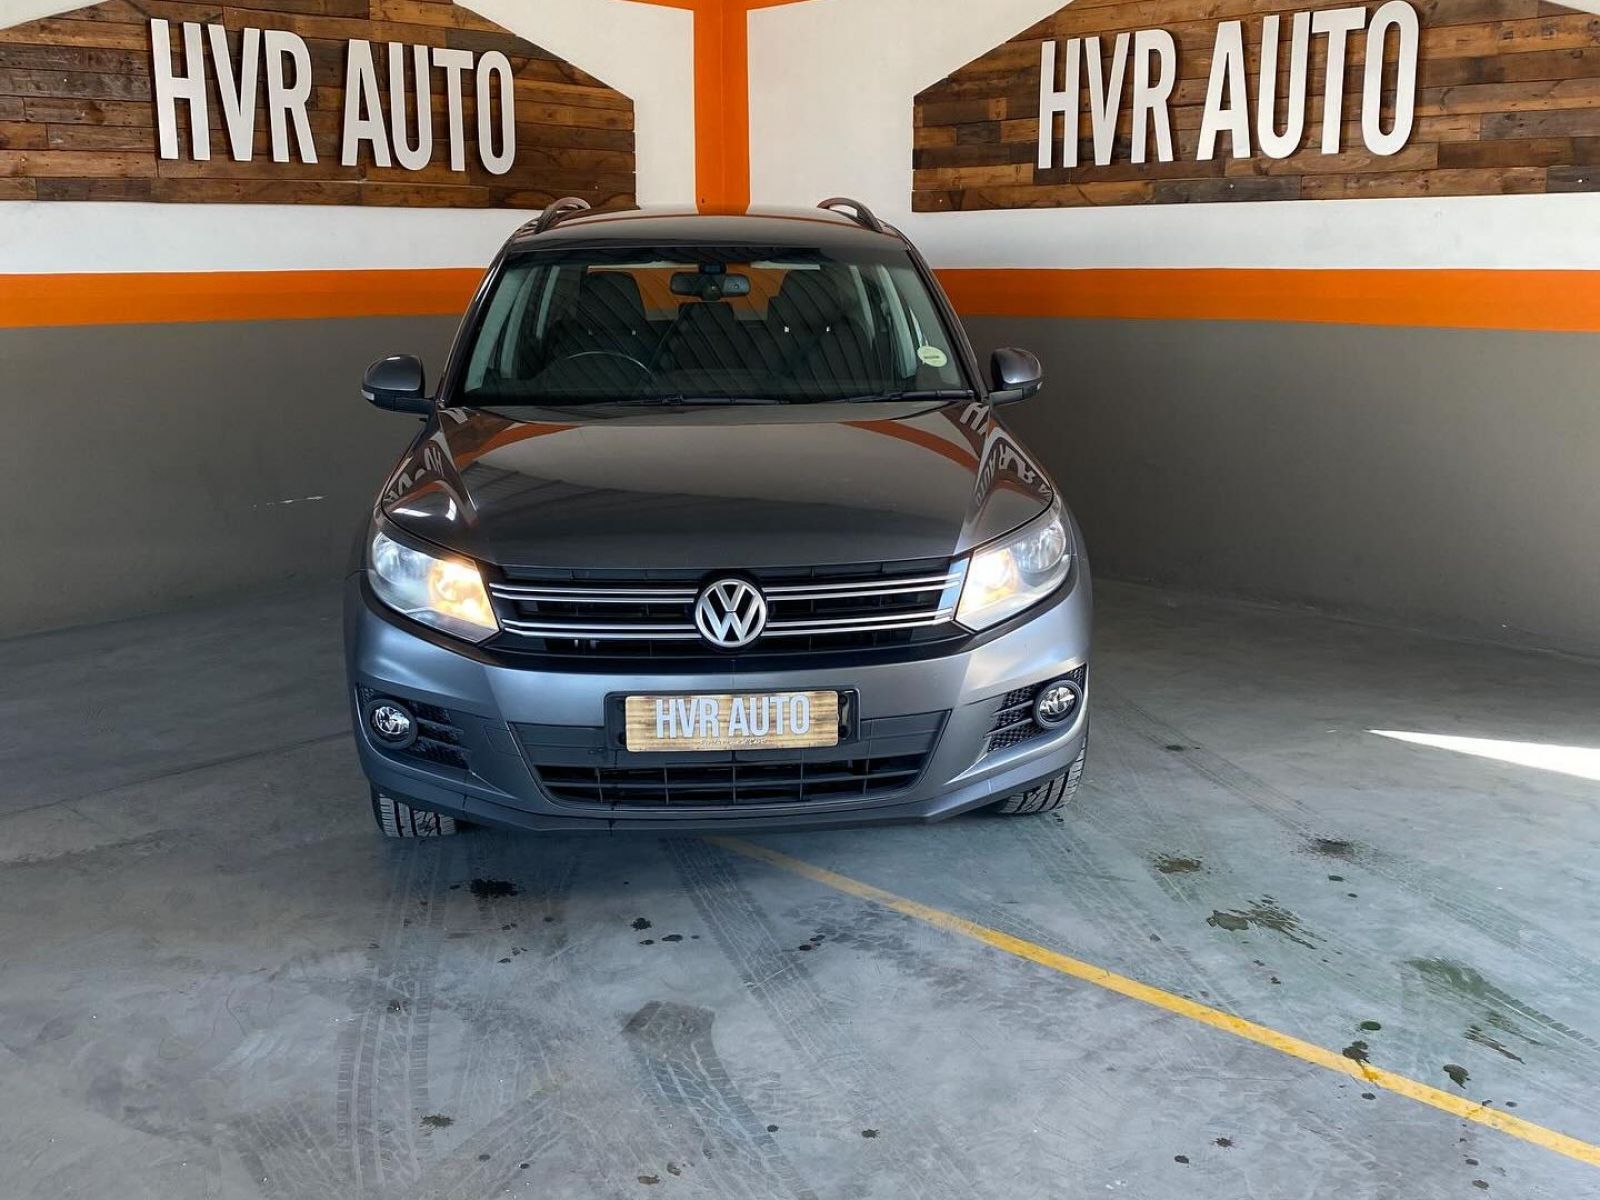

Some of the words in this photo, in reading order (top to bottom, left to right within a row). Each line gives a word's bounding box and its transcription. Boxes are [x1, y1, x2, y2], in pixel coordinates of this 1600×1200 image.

[151, 19, 318, 163] HVR
[342, 39, 515, 174] AUTO
[1038, 29, 1176, 169] HVR
[1197, 0, 1419, 160] AUTO
[655, 698, 720, 739] HVR
[728, 694, 810, 737] AUTO
